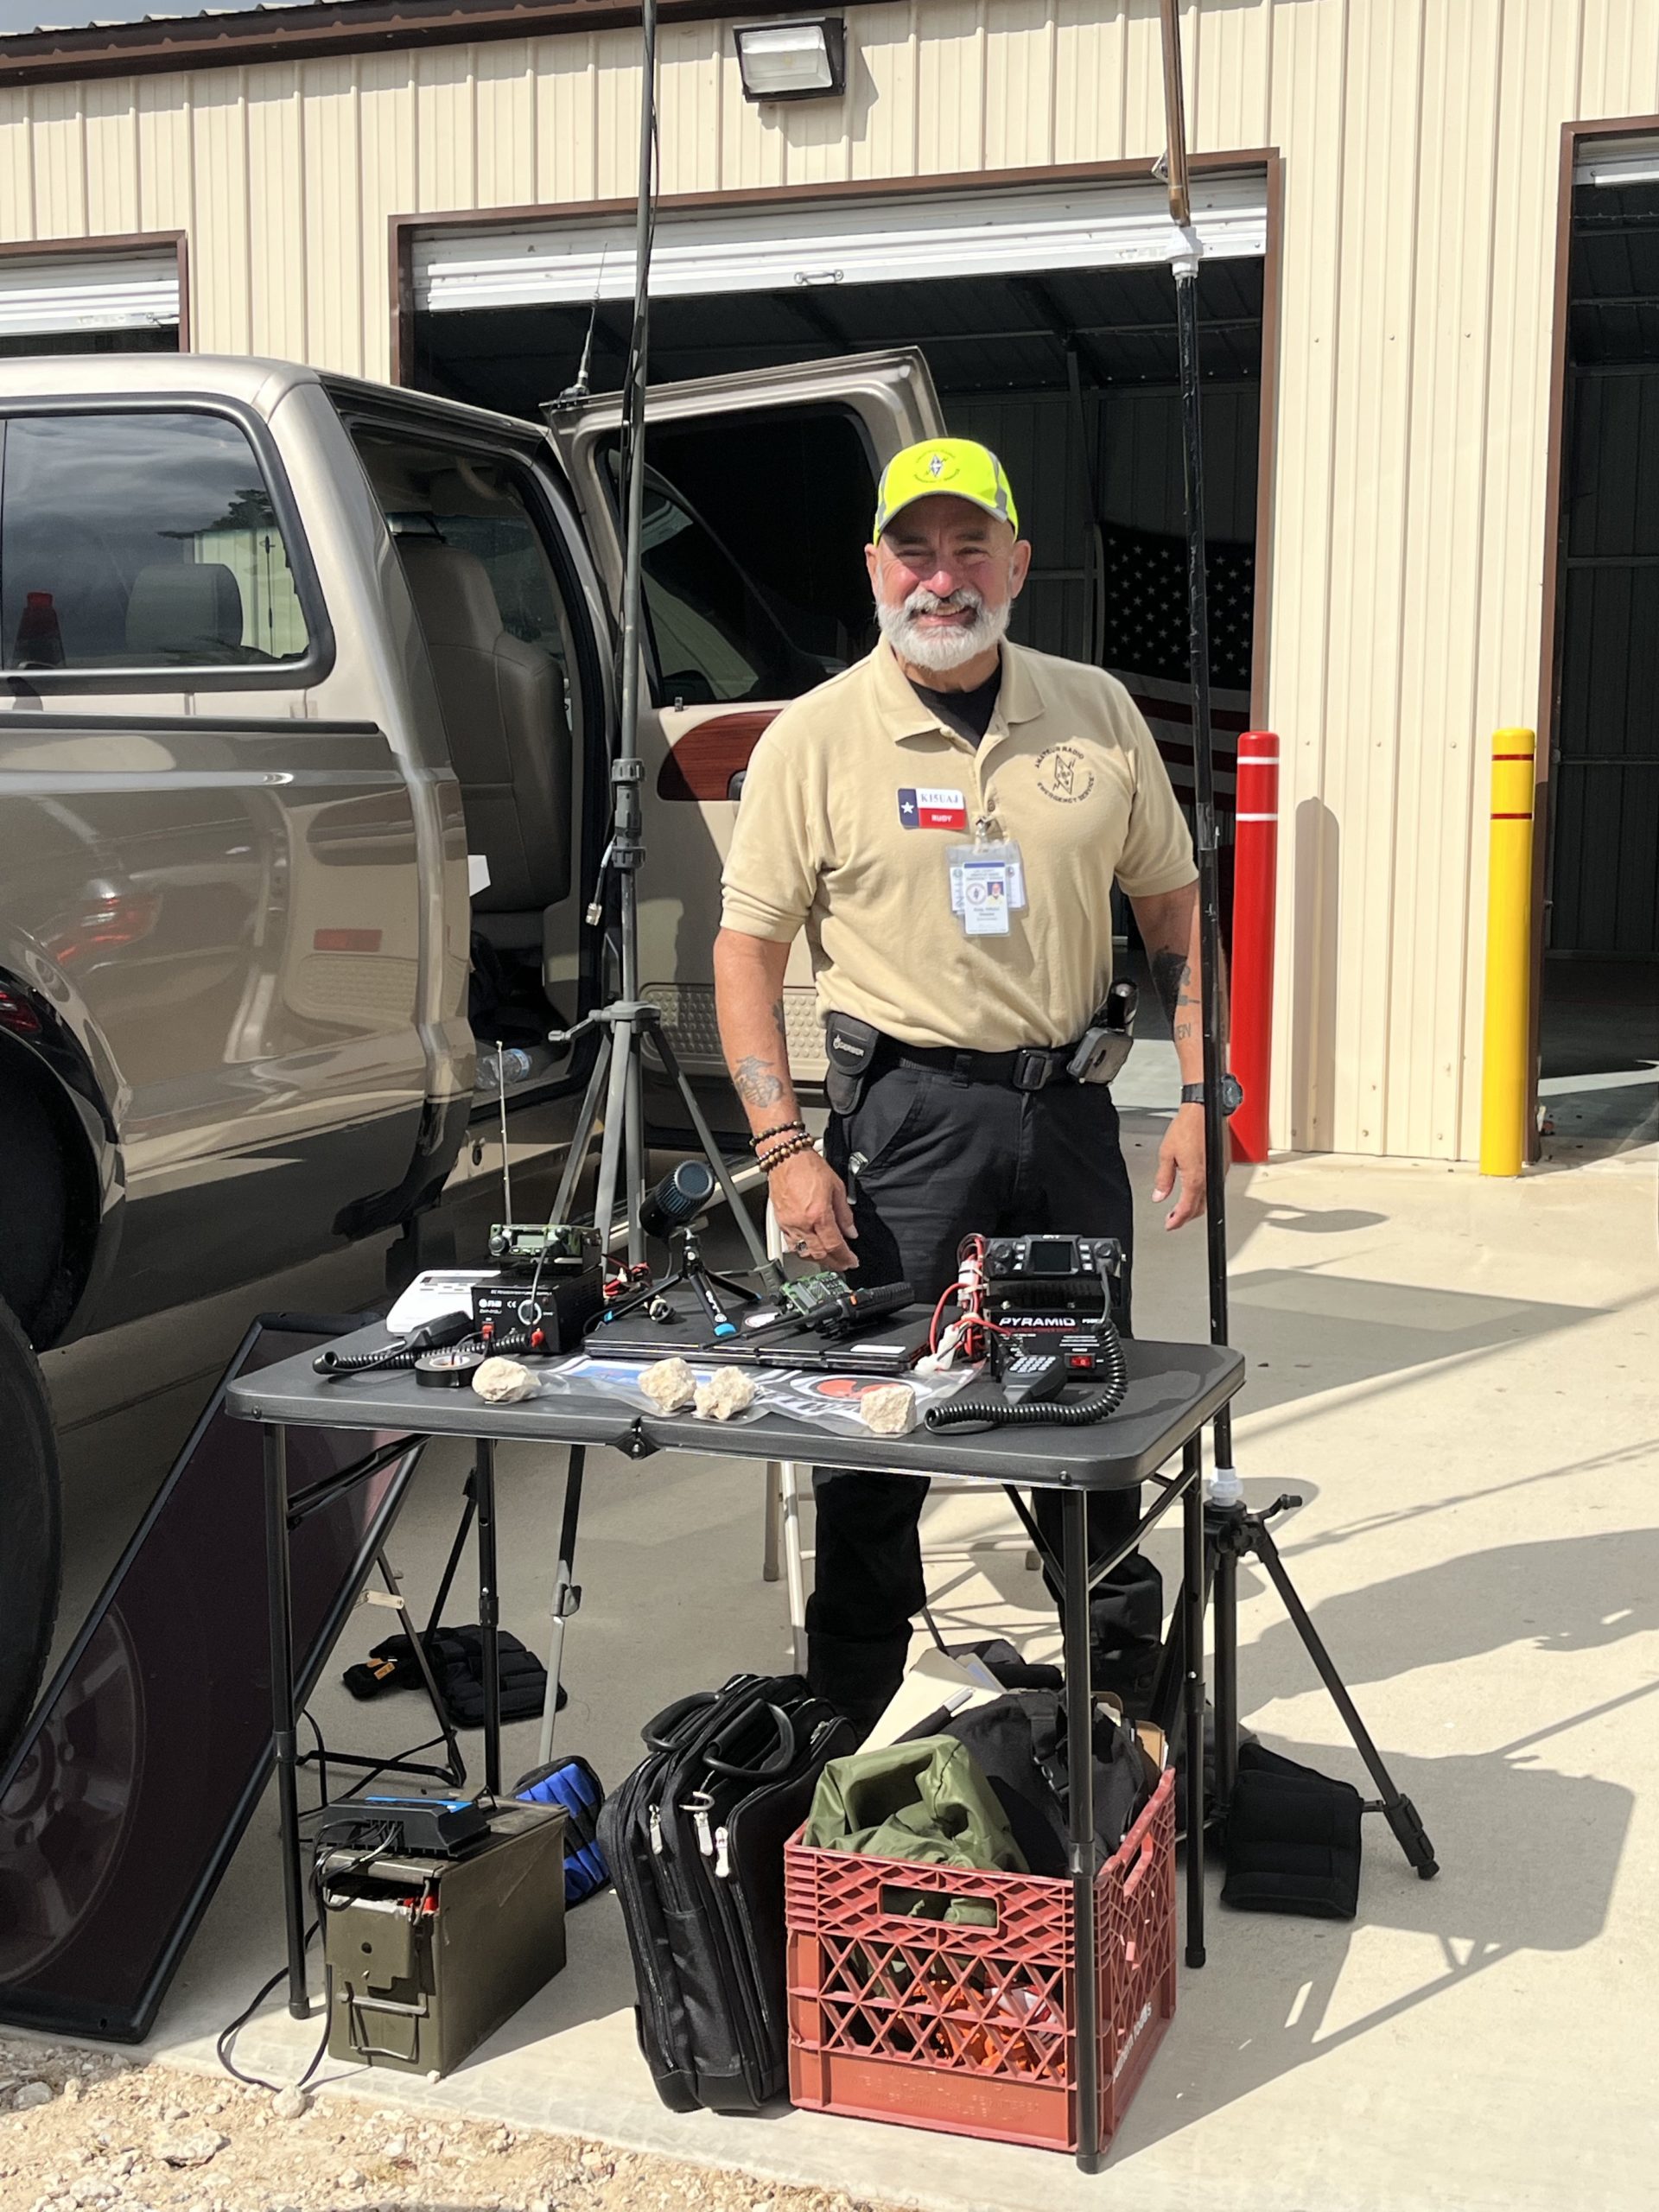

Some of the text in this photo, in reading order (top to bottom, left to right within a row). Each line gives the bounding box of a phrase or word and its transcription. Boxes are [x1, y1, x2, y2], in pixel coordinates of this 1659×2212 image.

[1035, 747, 1084, 768] AMATEUR RADIO
[1037, 777, 1095, 803] EMERGENCY SERVICE
[931, 814, 952, 823] RUDY
[999, 1317, 1076, 1326] PYRAMID
